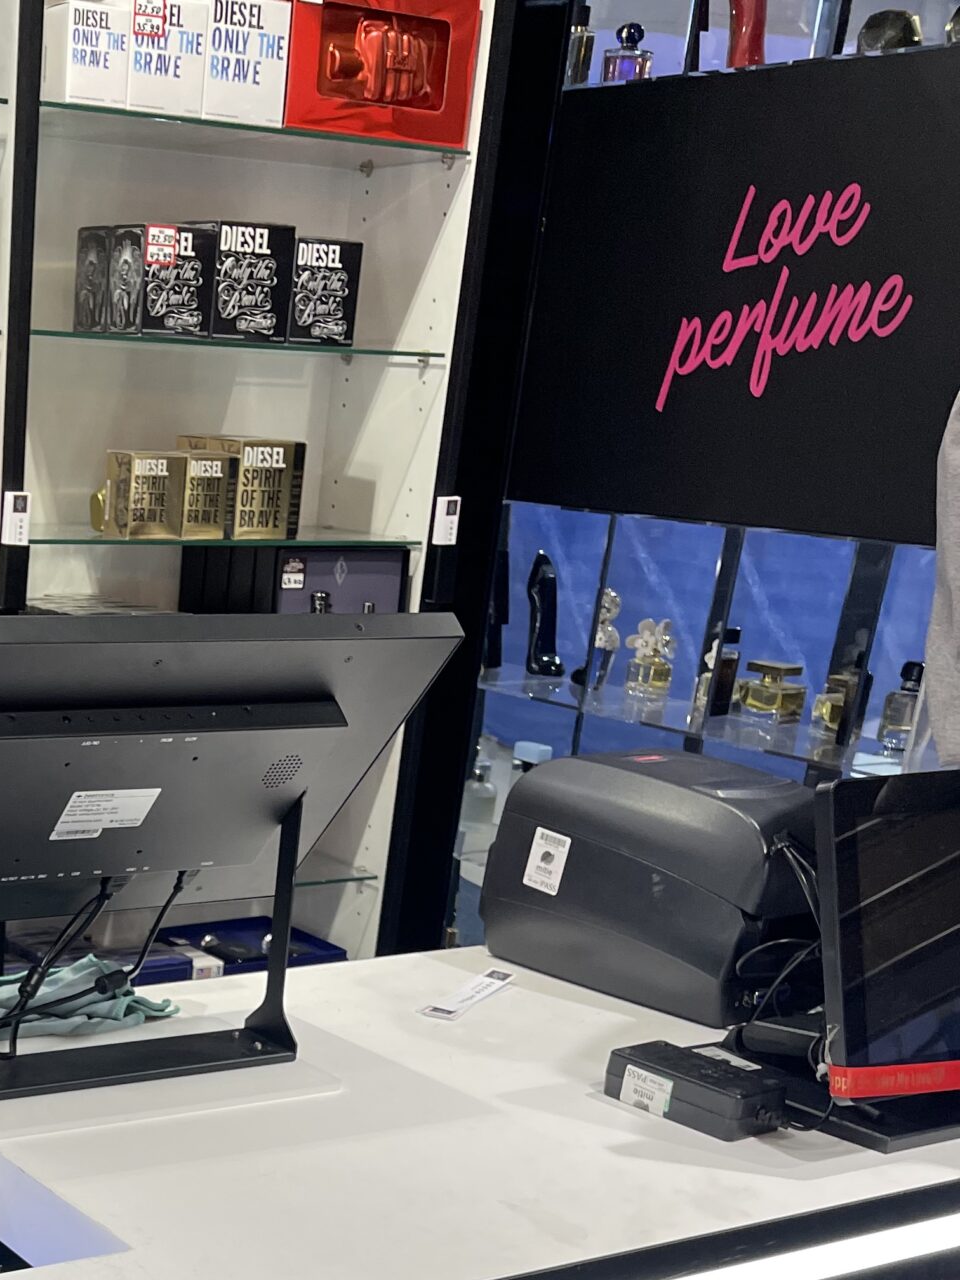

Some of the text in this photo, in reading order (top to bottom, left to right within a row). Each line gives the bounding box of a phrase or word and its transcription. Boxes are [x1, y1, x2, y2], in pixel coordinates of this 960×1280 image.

[73, 8, 111, 30] DIESEL
[214, 0, 264, 30] DIESEL
[72, 27, 126, 51] ONLY THE
[135, 30, 203, 55] ONLY THE
[212, 27, 284, 61] ONLY THE
[72, 48, 109, 70] BRAVE
[134, 51, 181, 79] BRAVE
[211, 55, 261, 86] BRAVE
[722, 182, 872, 272] Love
[220, 225, 271, 255] DIESEL
[297, 242, 343, 268] DIESEL
[654, 265, 914, 414] perfume
[135, 459, 169, 476] DIESEL
[243, 446, 286, 468] DIESEL
[190, 461, 223, 477] DIESEL
[242, 468, 283, 488] SPIRIT
[134, 476, 168, 492] SPIRIT
[190, 477, 221, 492] SPIRIT
[133, 492, 166, 507] OF THE
[189, 493, 219, 508] OF THE
[241, 489, 282, 508] OF THE
[132, 508, 165, 523] BRAVE
[187, 508, 218, 524] BRAVE
[240, 510, 279, 529] BRAVE
[627, 1068, 648, 1084] PASS
[632, 1087, 654, 1101] mitie
